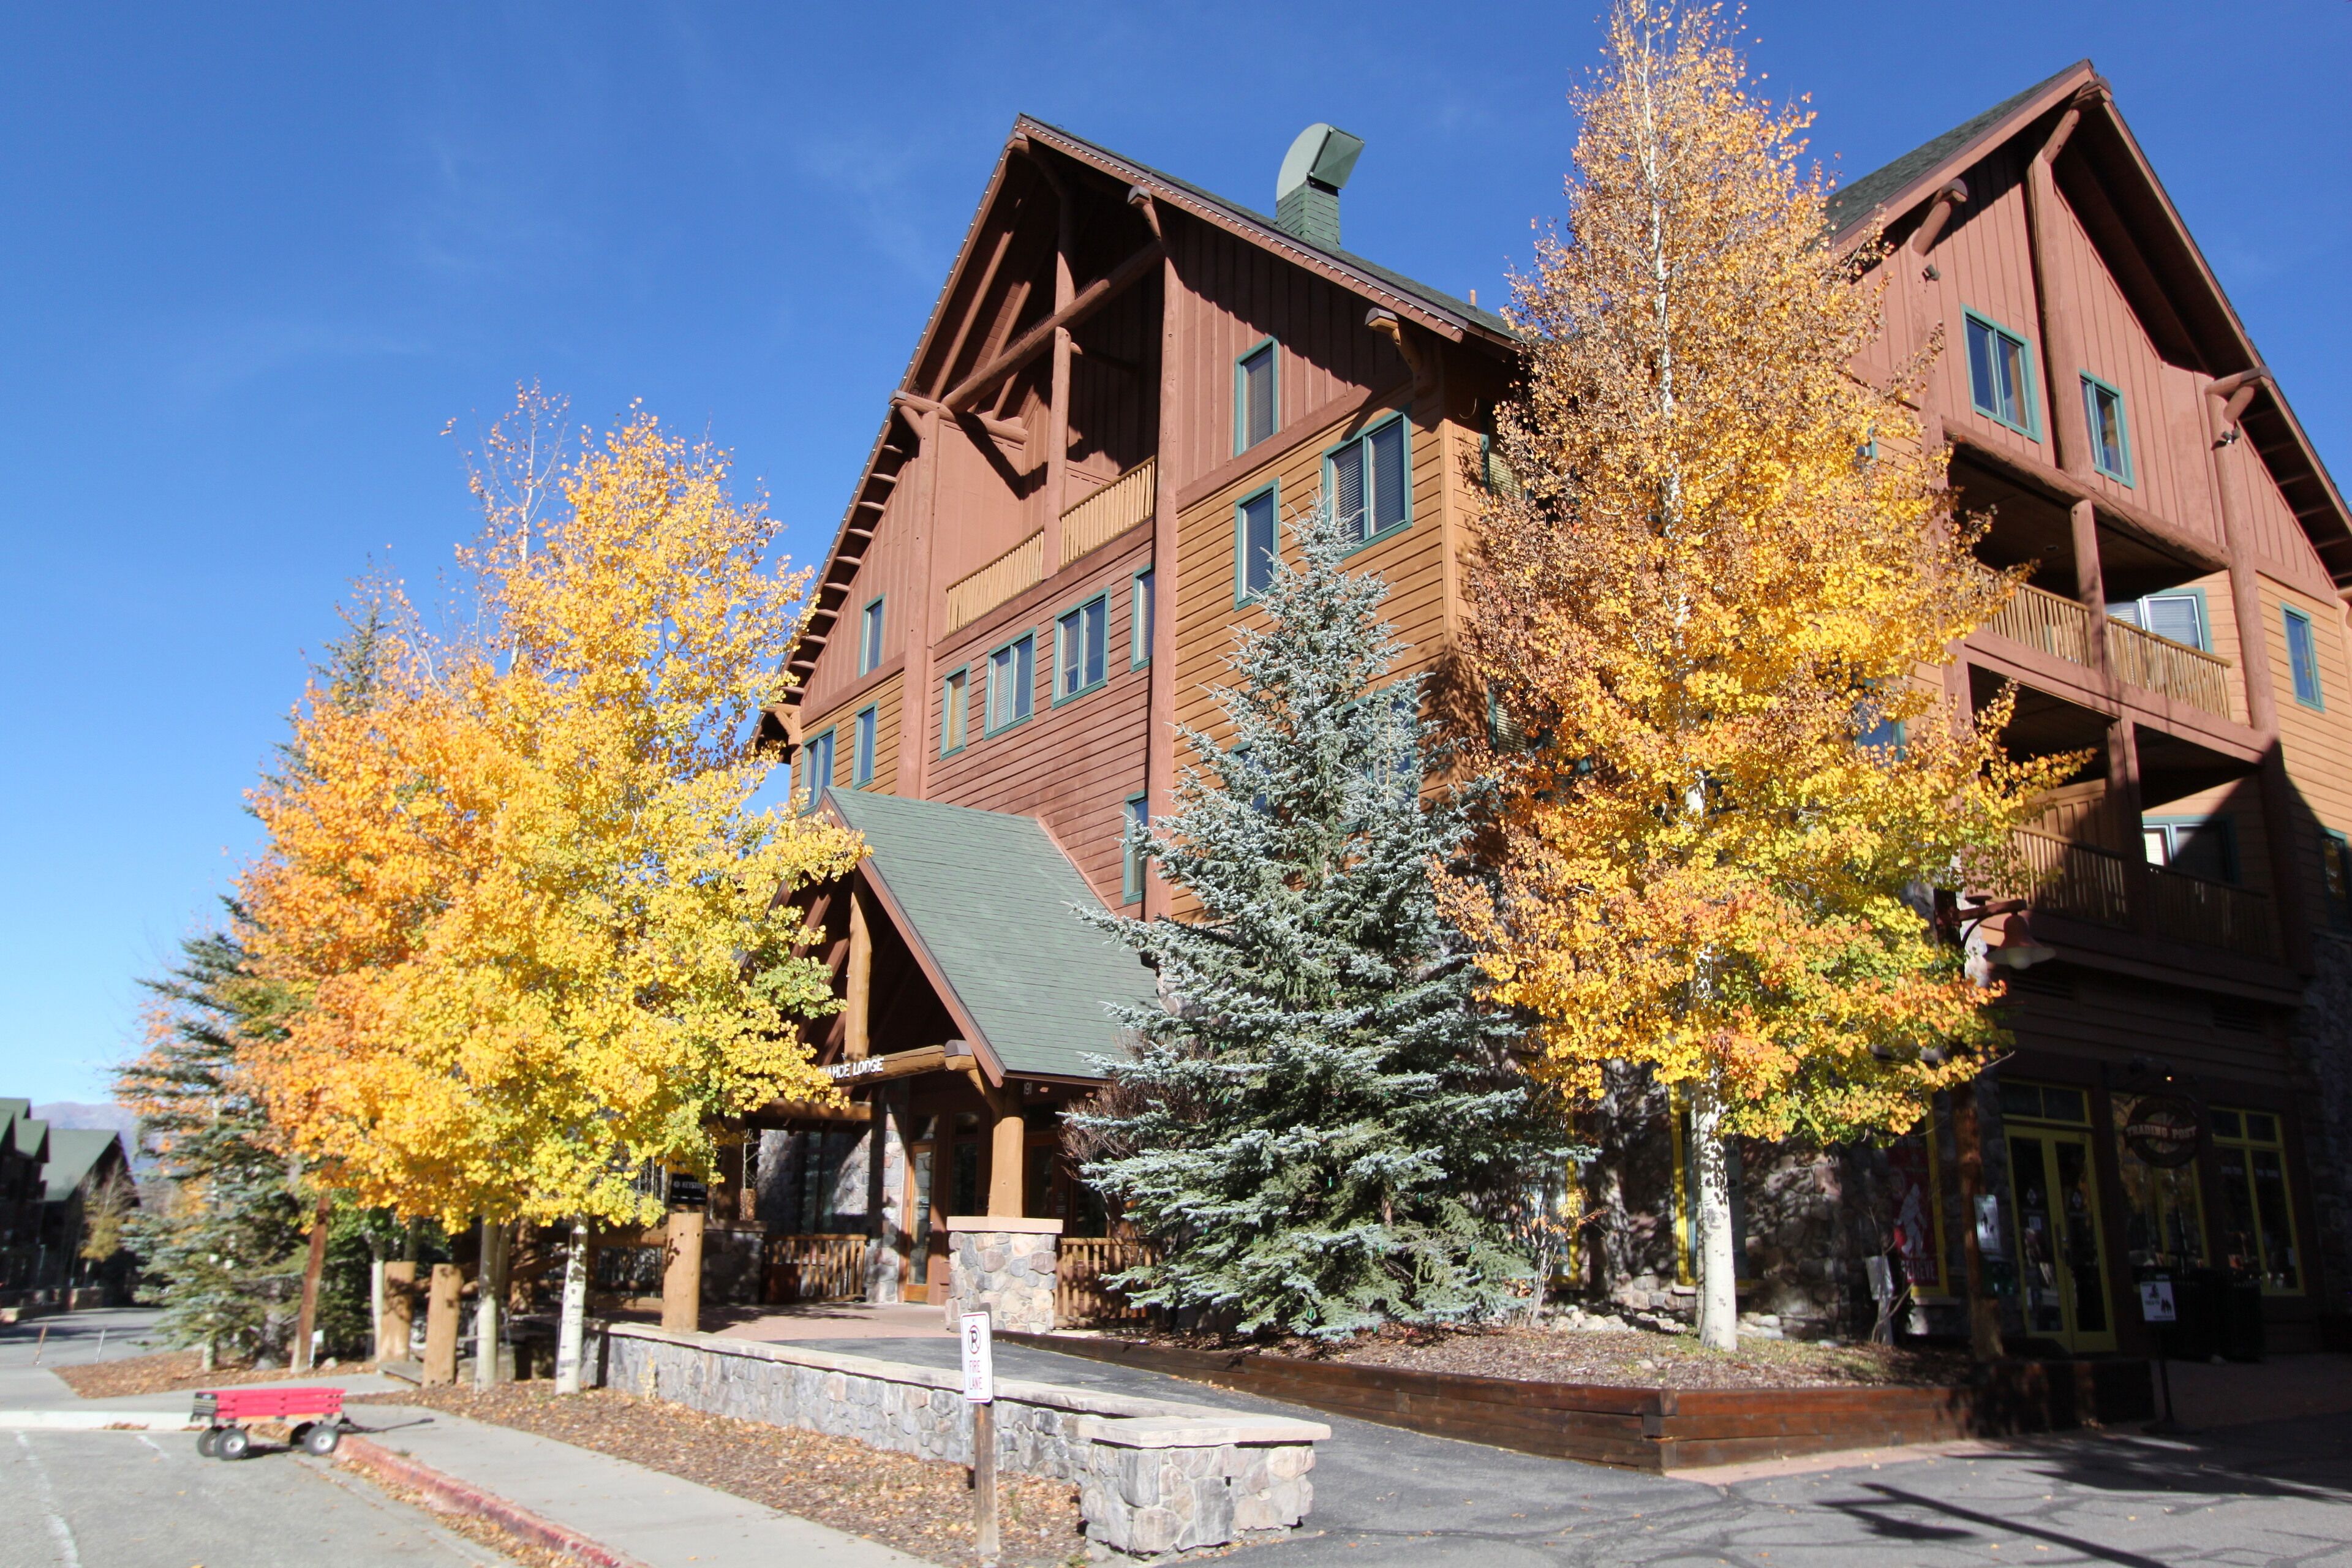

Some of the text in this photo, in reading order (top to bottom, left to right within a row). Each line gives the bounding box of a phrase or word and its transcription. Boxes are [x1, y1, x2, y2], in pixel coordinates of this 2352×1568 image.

[852, 1057, 884, 1076] LODGE
[2125, 1124, 2196, 1139] TRADING POST
[969, 1360, 980, 1373] FIRE
[969, 1376, 982, 1390] LANE
